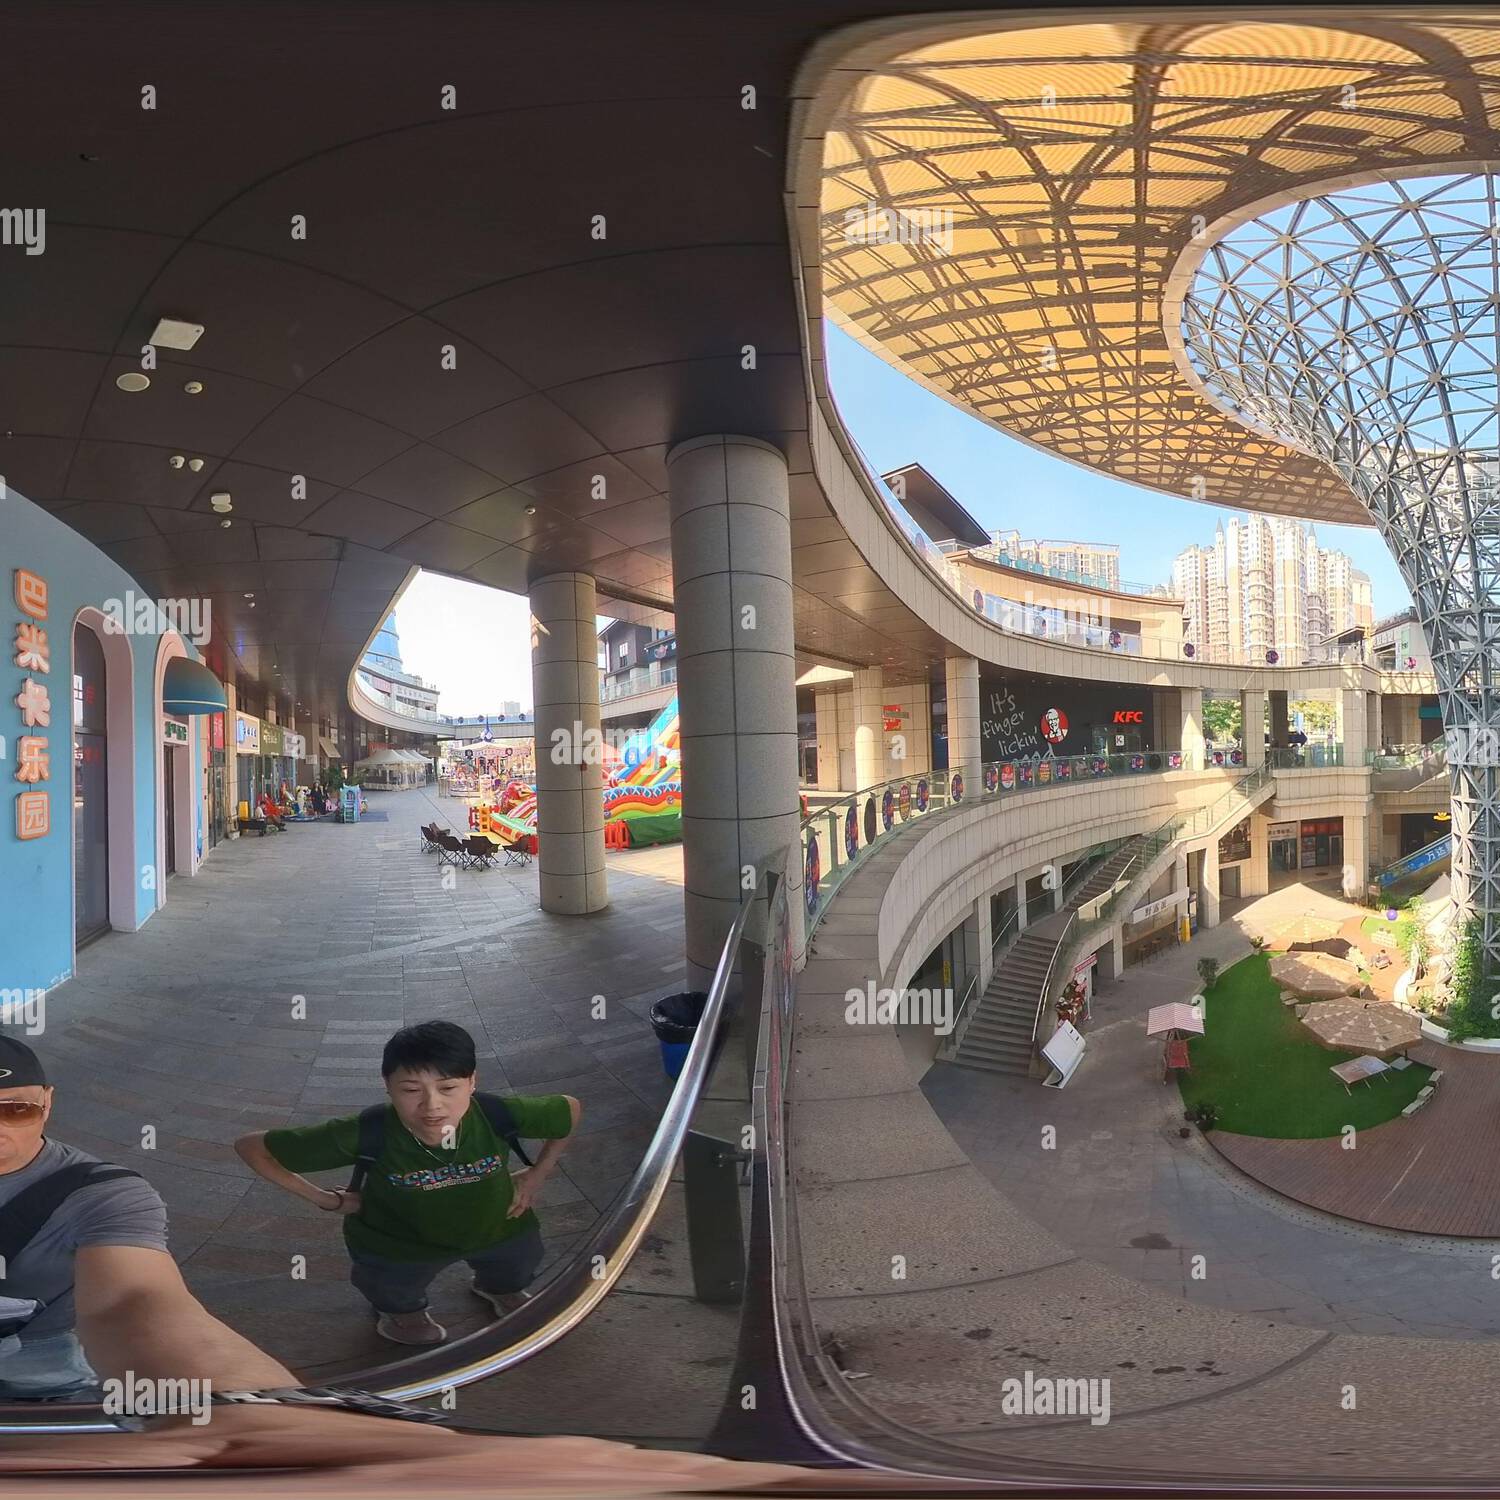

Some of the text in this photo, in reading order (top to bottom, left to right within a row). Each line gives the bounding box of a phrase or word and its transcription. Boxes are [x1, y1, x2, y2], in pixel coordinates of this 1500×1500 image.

[13, 567, 50, 840] 巴米卡乐园
[990, 687, 1016, 714] It's
[982, 711, 1024, 738] finger
[1113, 711, 1144, 723] KFC
[998, 726, 1037, 756] lickin'
